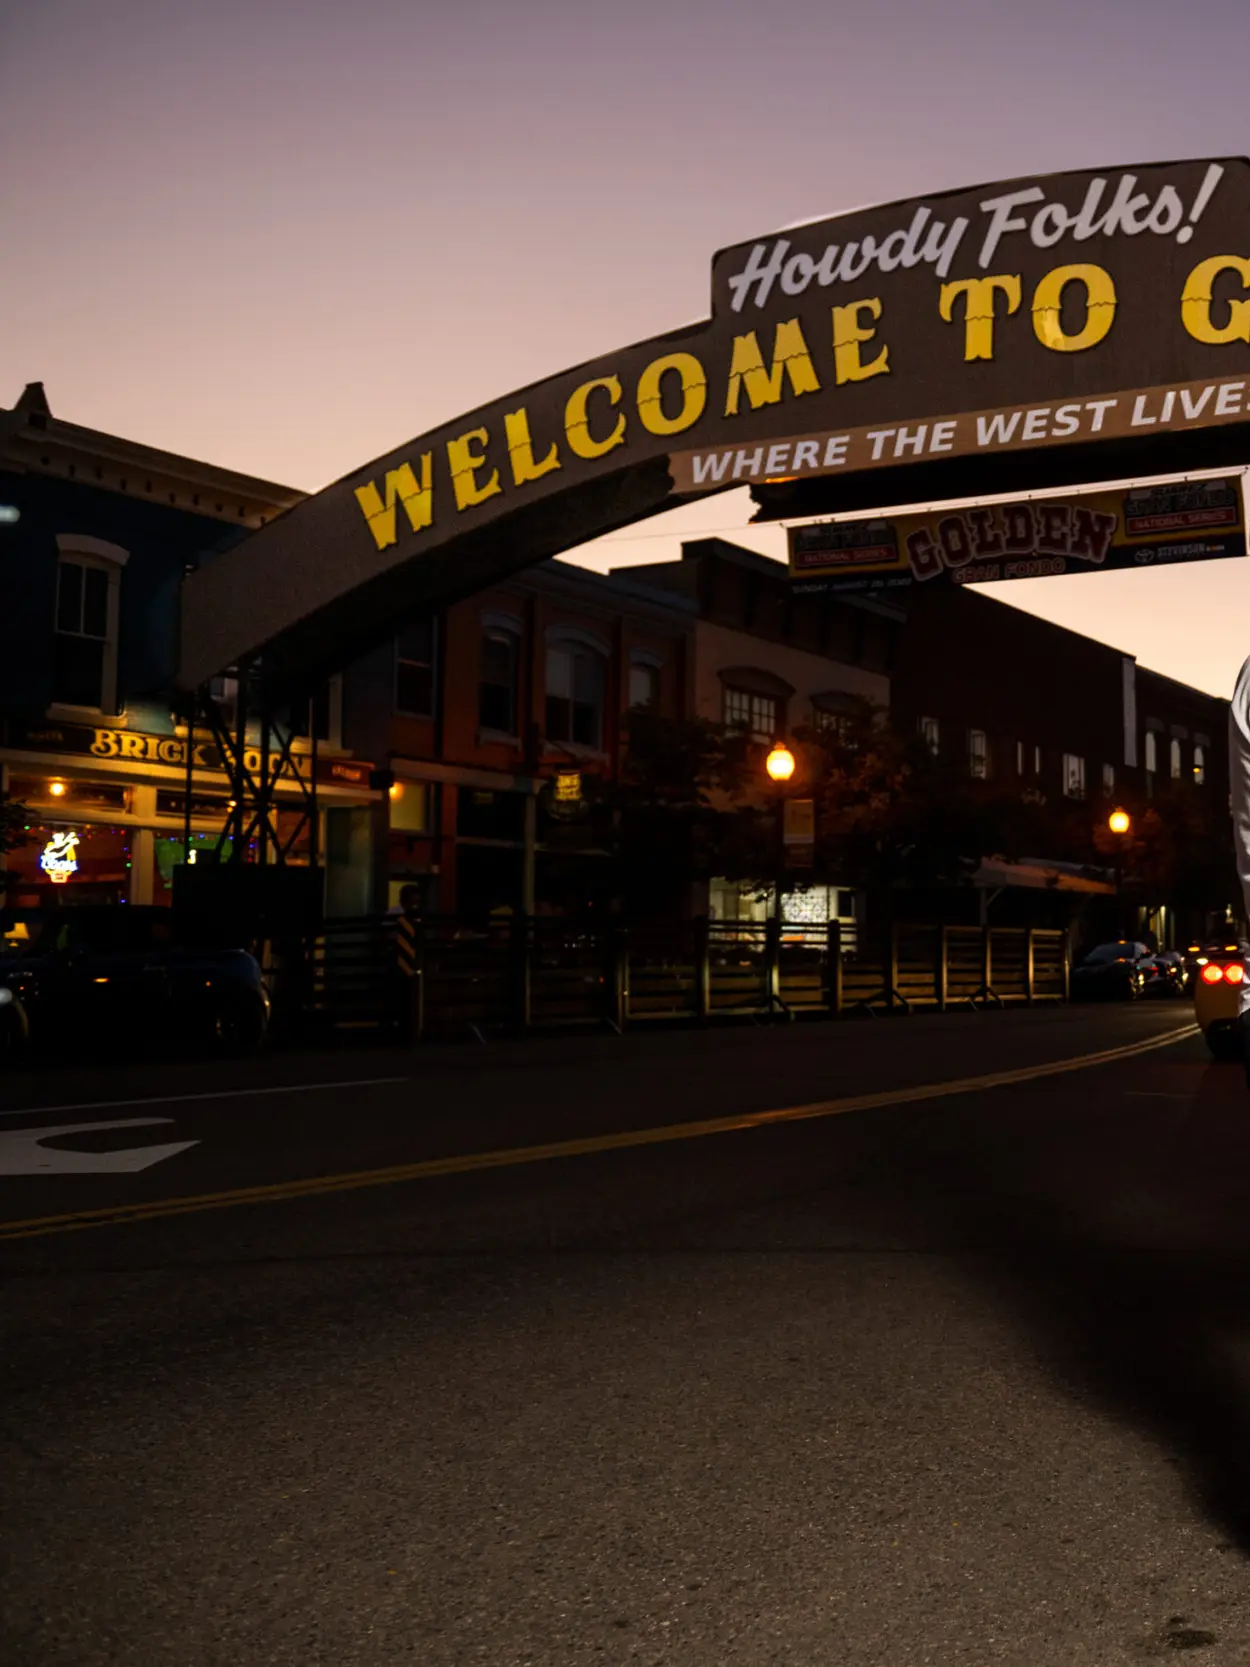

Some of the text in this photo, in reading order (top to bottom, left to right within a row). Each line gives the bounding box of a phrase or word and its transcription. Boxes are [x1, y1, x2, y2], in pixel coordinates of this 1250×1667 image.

[728, 163, 1225, 313] Howdy Folks!
[353, 297, 891, 551] WELCOME
[938, 262, 1117, 362] TO
[690, 434, 850, 486] WHERE
[865, 420, 958, 462] THE
[974, 399, 1119, 447] WEST
[904, 502, 1119, 582] GOLDEN
[951, 557, 1067, 584] GRAN FONDO
[89, 728, 208, 766] BRICK
